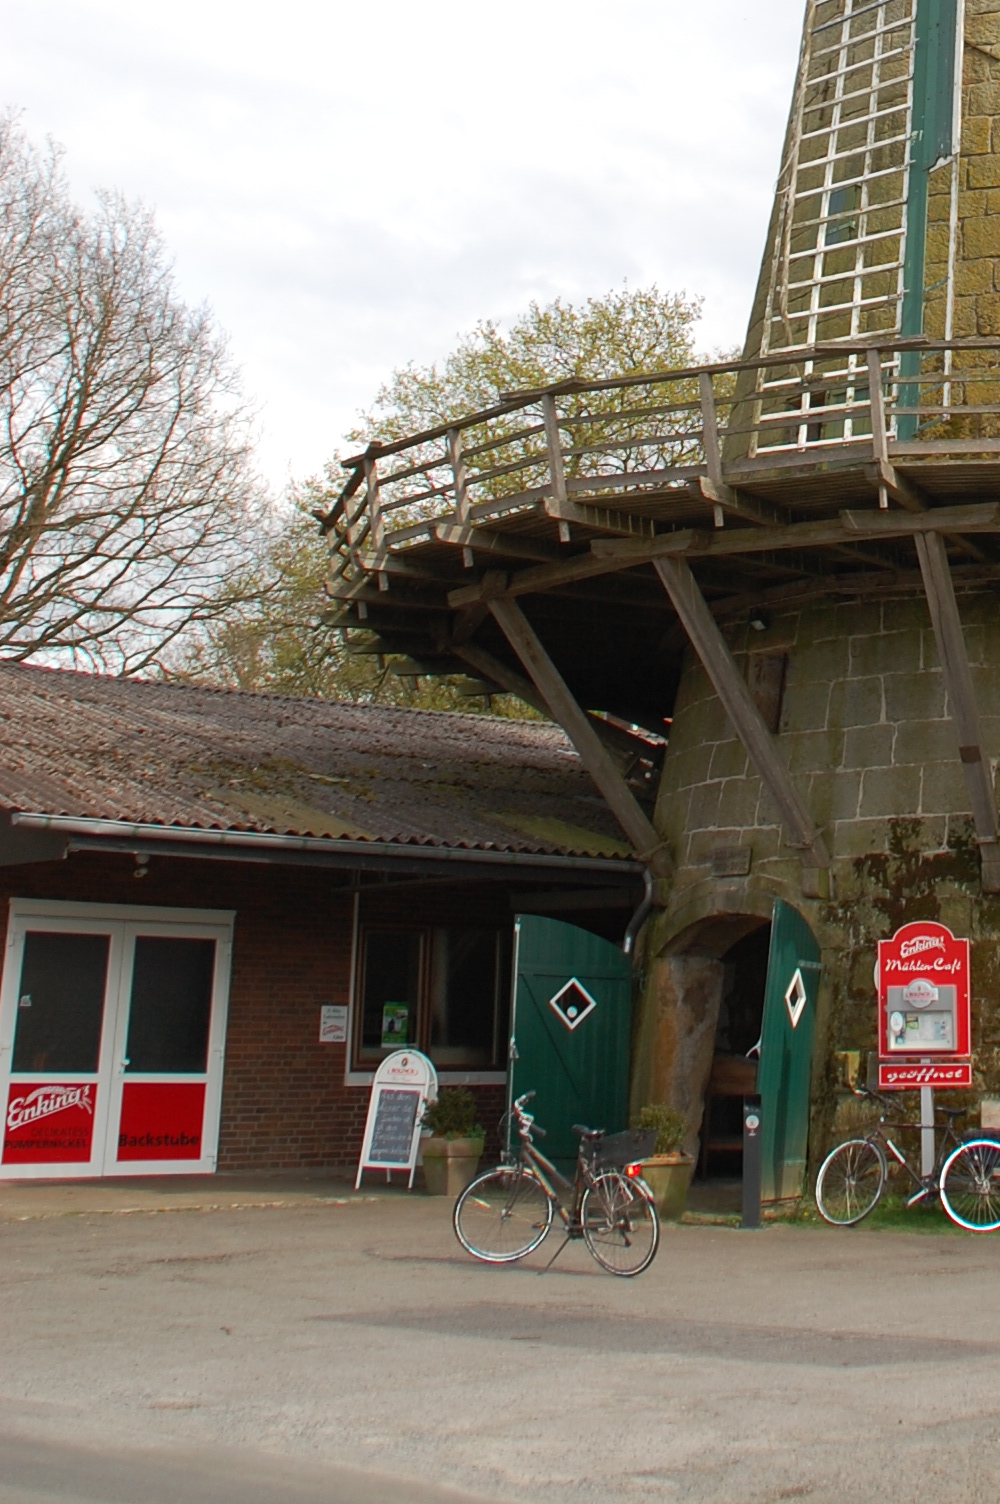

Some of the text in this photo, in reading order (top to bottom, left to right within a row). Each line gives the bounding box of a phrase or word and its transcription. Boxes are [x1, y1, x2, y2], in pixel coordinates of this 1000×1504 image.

[886, 1067, 963, 1083] geöffnet
[7, 1084, 91, 1129] Enking's
[118, 1131, 200, 1147] Backstube
